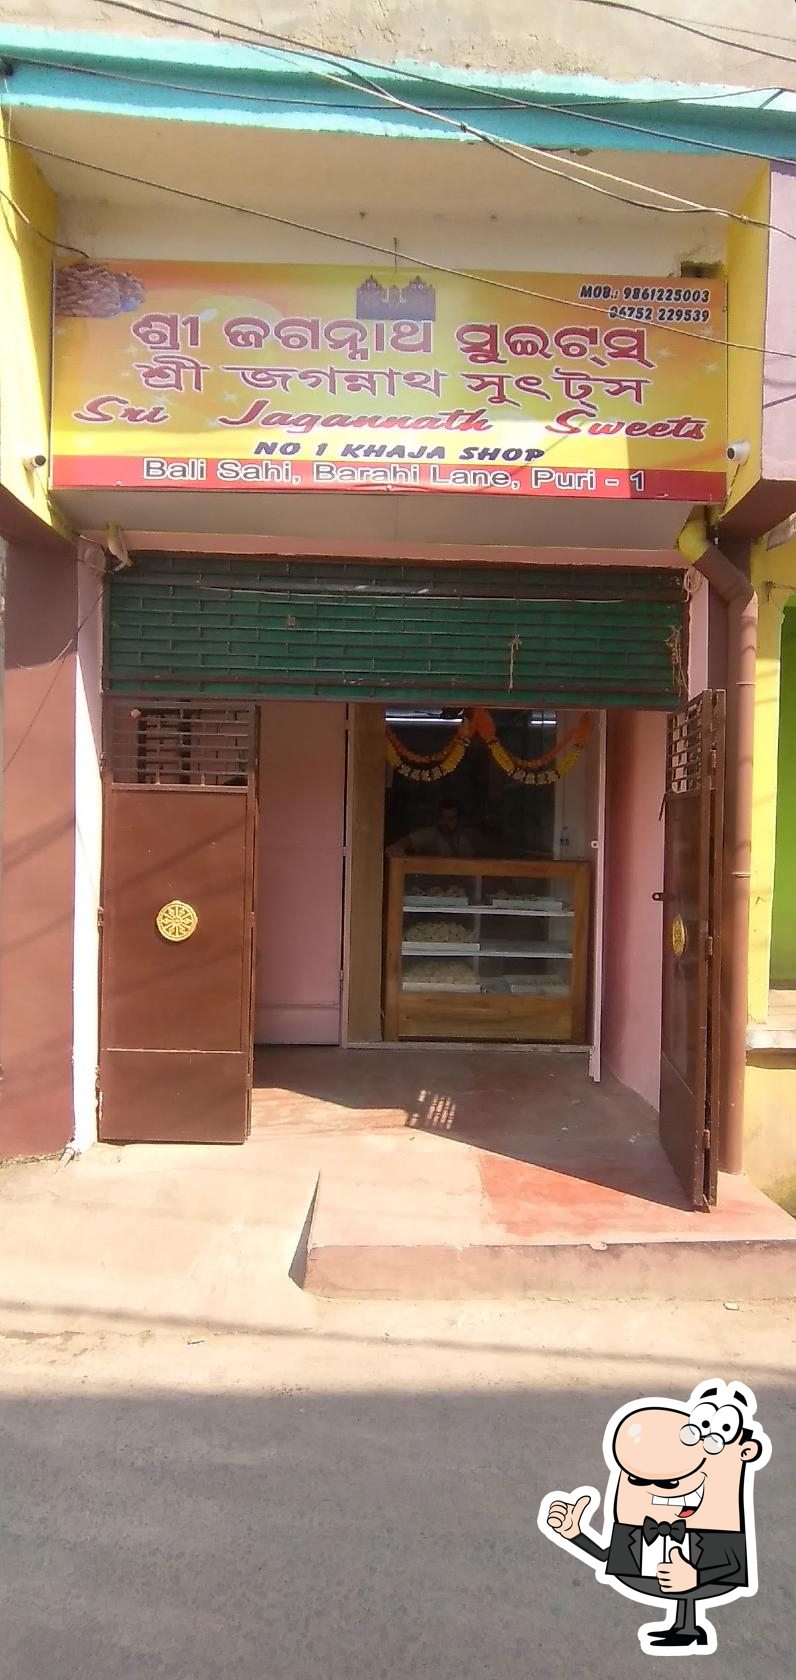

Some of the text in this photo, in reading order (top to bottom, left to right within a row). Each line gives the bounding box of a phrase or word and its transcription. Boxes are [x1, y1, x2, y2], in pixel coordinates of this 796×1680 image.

[624, 287, 709, 302] 9861225003
[659, 308, 710, 322] 229539
[224, 315, 432, 360] ଜଗନ୍ନାଥ
[222, 366, 448, 397] জগন্নাথ
[74, 396, 707, 440] Sri Jagannath Sweets
[254, 442, 545, 462] NO 1 KHAJA SHOP
[143, 458, 204, 480] Bali
[217, 460, 302, 484] Sahi,
[312, 463, 420, 484] Barahi
[431, 466, 520, 490] Lane,
[531, 469, 596, 490] Puri
[630, 471, 646, 491] 1
